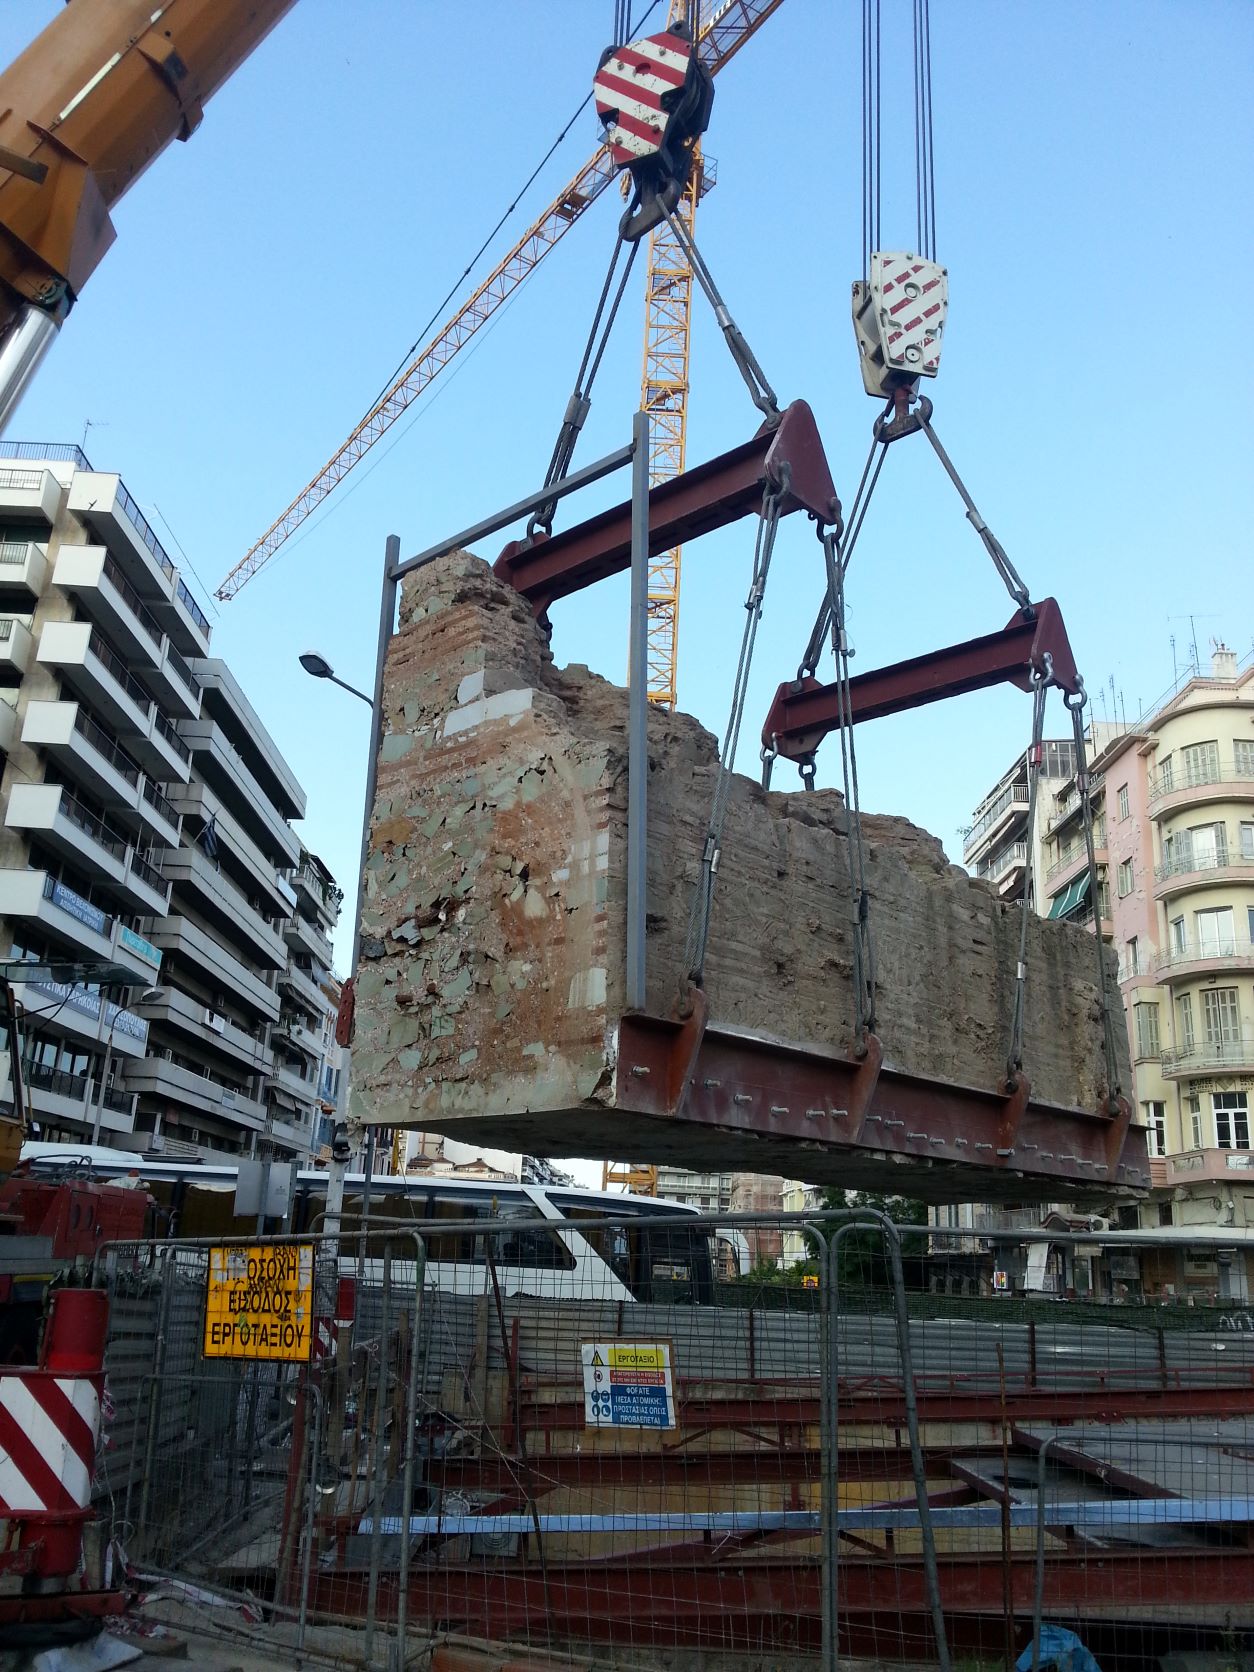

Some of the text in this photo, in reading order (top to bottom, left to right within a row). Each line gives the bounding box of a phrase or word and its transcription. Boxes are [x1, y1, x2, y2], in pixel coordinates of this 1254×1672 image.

[226, 1258, 297, 1281] ΟΣΟΧΗ
[229, 1290, 292, 1313] ΕΙΣΟΔΟΣ
[211, 1322, 305, 1348] ΕΡΓΟΤΑΞΙΟΥ
[618, 1355, 655, 1364] ΕΡΓΟΤΑΞΙΟ
